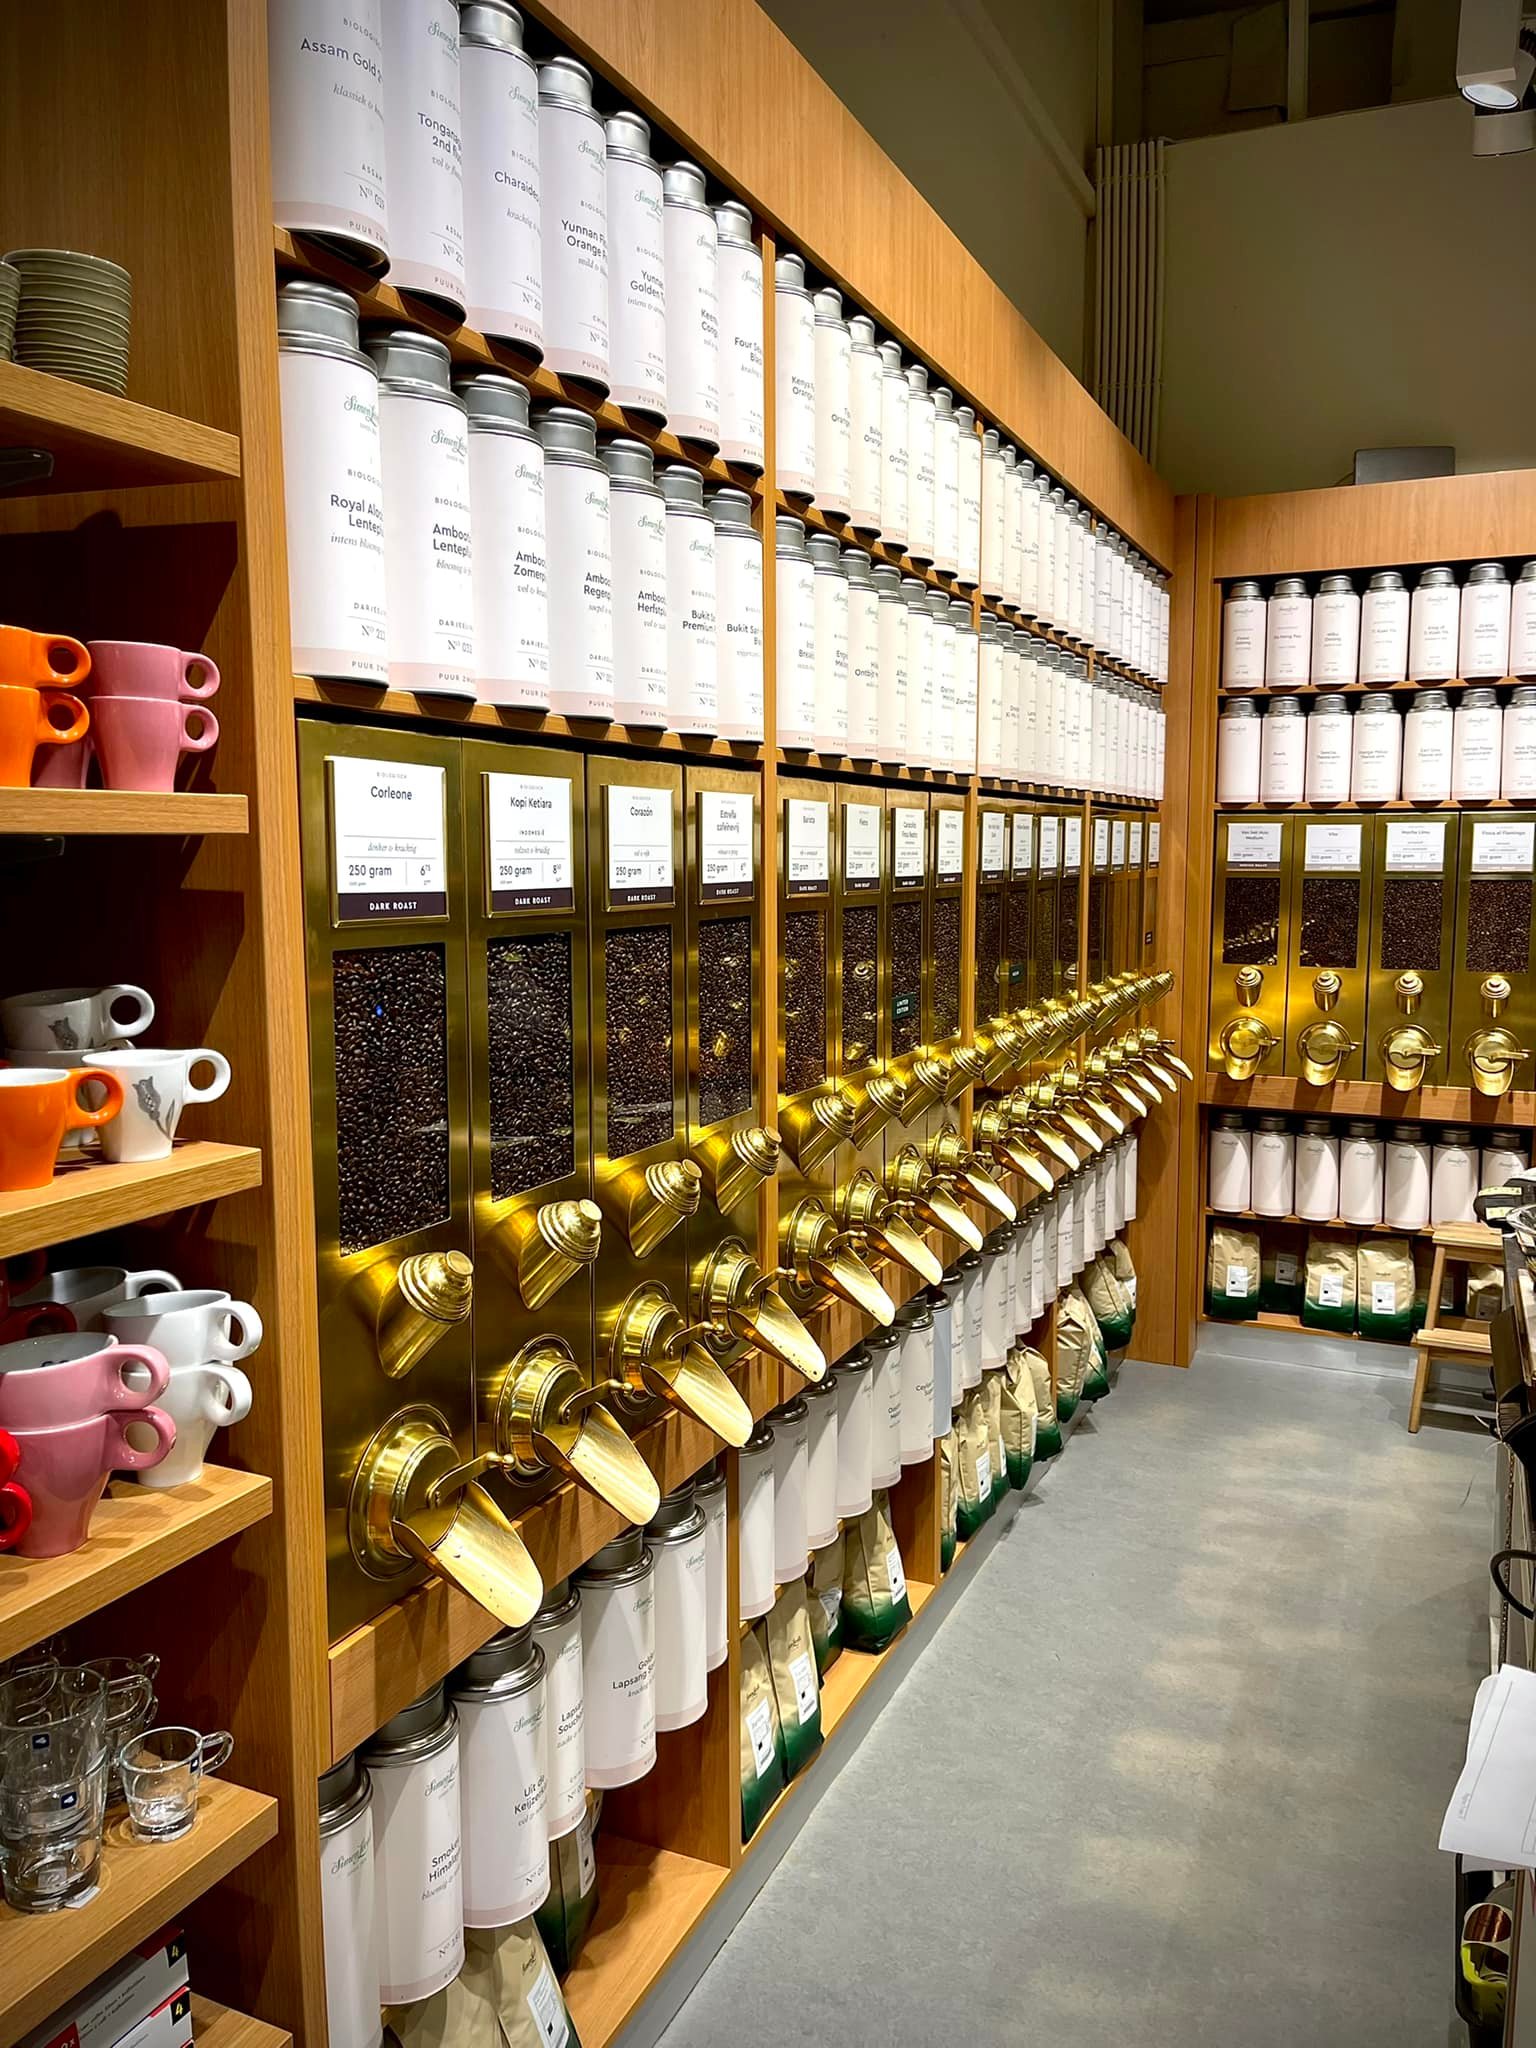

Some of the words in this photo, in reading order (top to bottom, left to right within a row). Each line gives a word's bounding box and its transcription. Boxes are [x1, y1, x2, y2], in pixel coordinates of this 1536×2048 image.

[300, 37, 349, 61] Assam
[352, 52, 377, 77] Gold
[432, 135, 451, 154] 2nd
[349, 220, 373, 236] PUUR
[561, 219, 598, 242] Yunnan
[566, 235, 601, 257] Orange
[734, 336, 752, 349] Four
[330, 494, 365, 513] Royal
[330, 532, 358, 547] intens
[691, 610, 710, 620] Bukit
[727, 623, 749, 634] Bukit
[351, 660, 373, 670] PUUR
[438, 672, 460, 681] PUUR
[520, 688, 539, 697] PUUR
[370, 785, 413, 801] Corleone
[509, 796, 528, 810] Kopi
[528, 797, 553, 809] Ketiara
[348, 864, 367, 877] 250
[369, 866, 393, 879] gram
[499, 864, 514, 876] 250
[514, 866, 533, 878] gram
[616, 866, 627, 876] 250
[627, 867, 643, 878] gram
[514, 896, 531, 906] DARK
[532, 895, 552, 905] ROAST
[627, 894, 640, 903] DARK
[369, 902, 391, 911] DARK
[393, 901, 418, 911] ROAST
[612, 1670, 648, 1690] Lapsang
[523, 1783, 537, 1799] Uit
